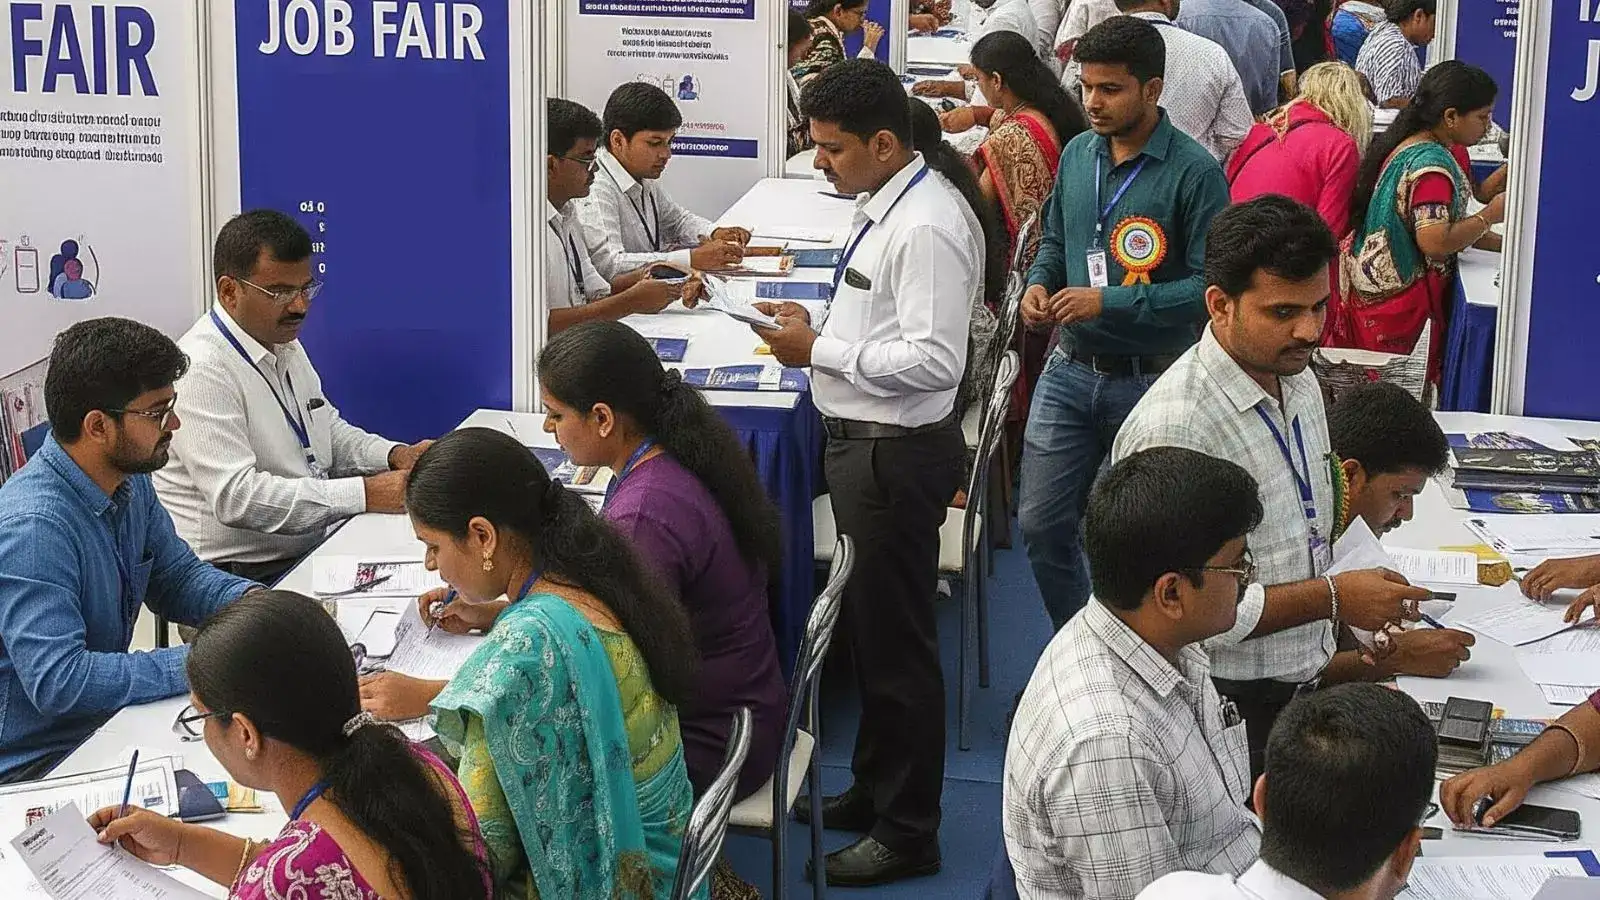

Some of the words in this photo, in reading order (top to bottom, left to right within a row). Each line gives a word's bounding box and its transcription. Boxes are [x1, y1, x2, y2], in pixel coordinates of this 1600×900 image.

[10, 3, 160, 97] FAIR
[258, 0, 355, 56] JOB
[373, 1, 486, 61] FAIR
